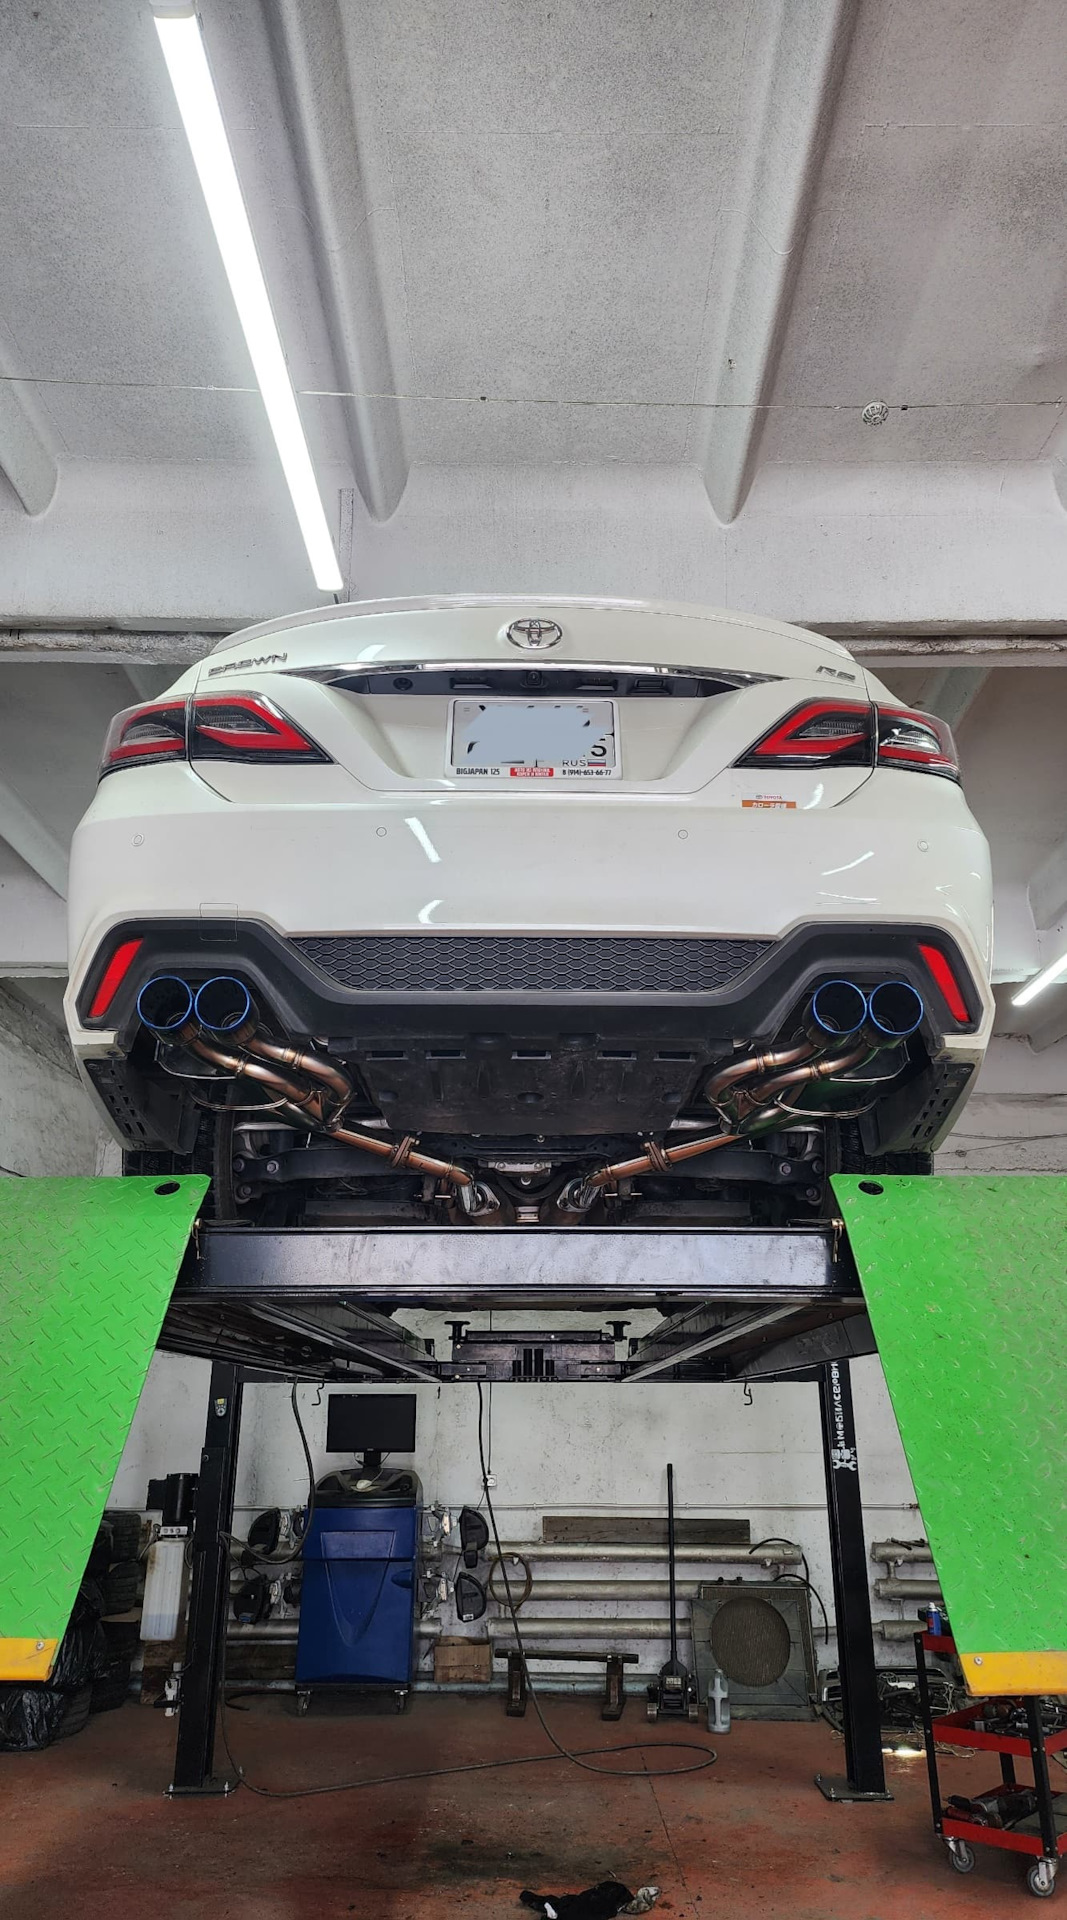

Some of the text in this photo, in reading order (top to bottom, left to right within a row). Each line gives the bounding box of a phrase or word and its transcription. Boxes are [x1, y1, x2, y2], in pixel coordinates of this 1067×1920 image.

[208, 652, 288, 677] CROWN
[815, 665, 856, 682] RS
[456, 767, 500, 776] BIGJAPAN 125
[562, 759, 587, 767] RUS
[830, 1360, 846, 1440] МОБИЛСЕРВИ
